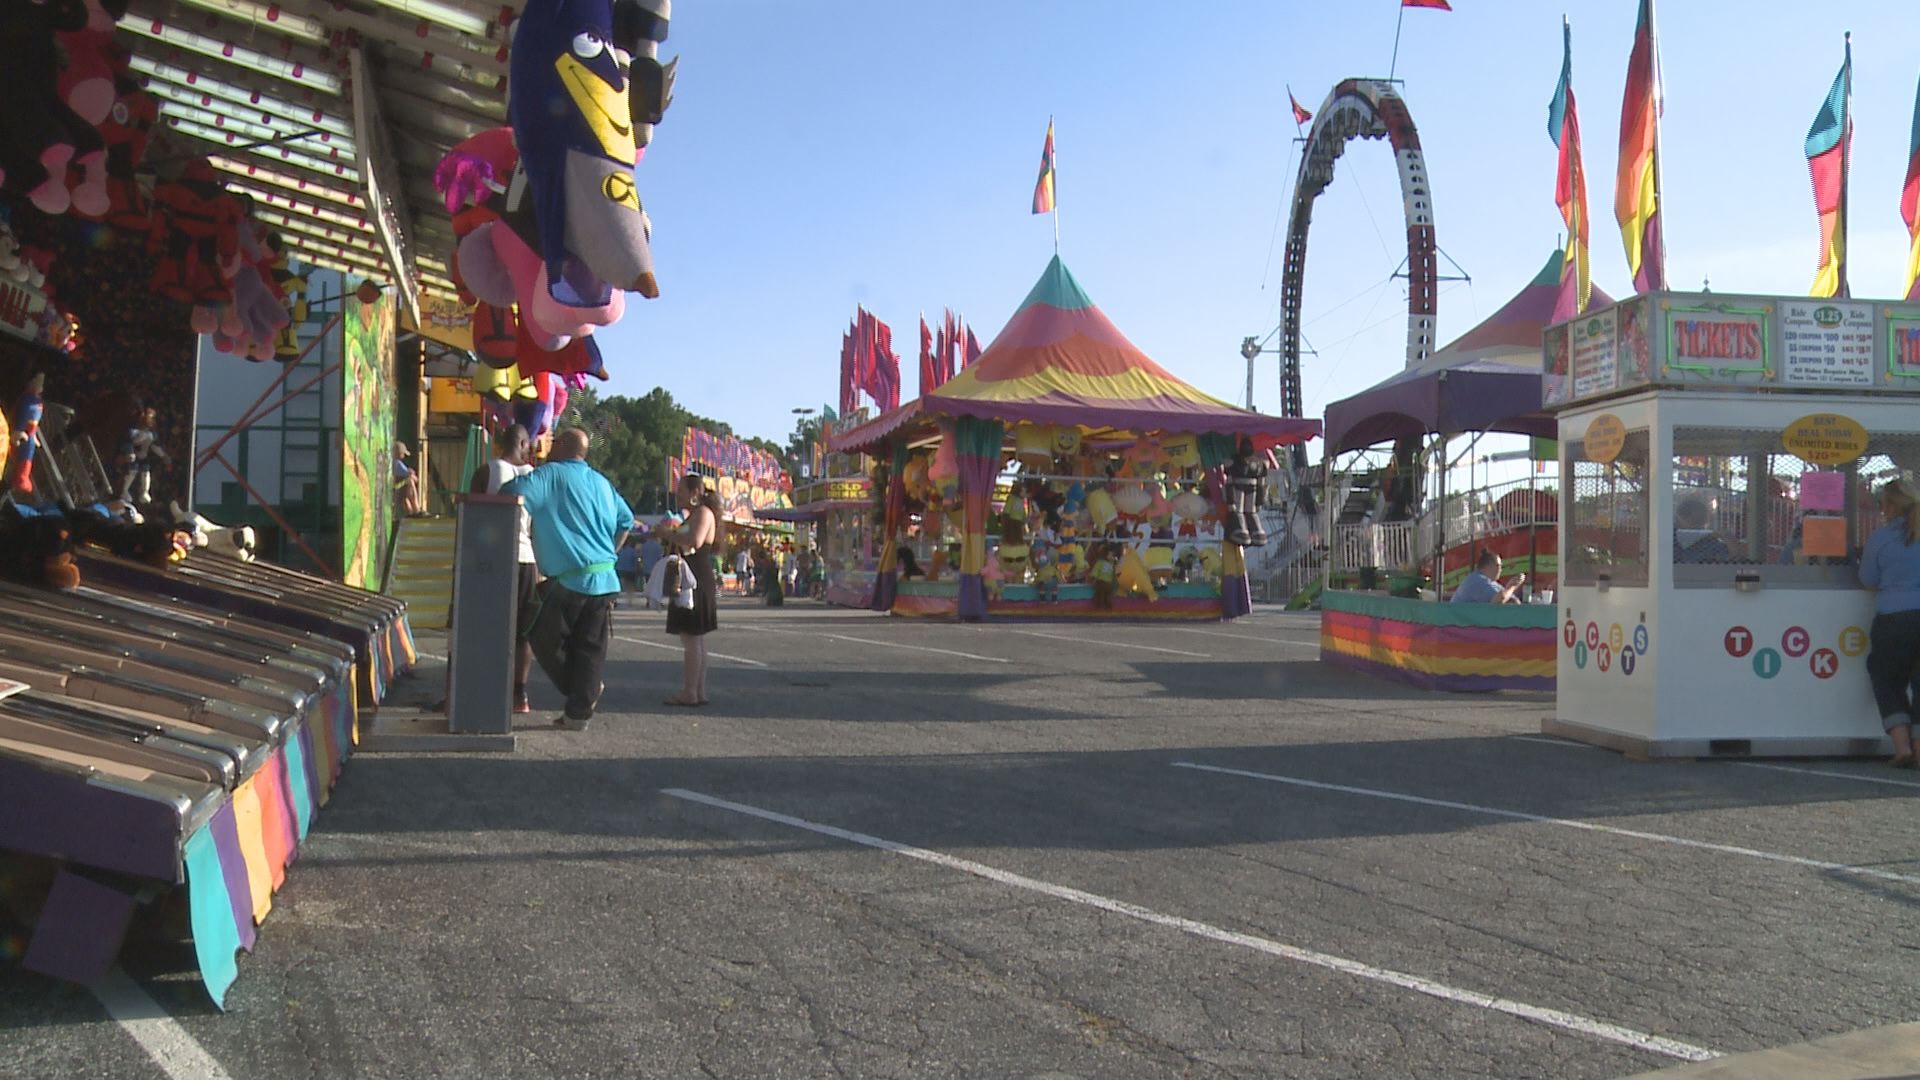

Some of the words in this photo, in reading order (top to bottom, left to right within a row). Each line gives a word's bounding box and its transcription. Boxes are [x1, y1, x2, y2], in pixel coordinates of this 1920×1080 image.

[1674, 319, 1761, 360] TICKETS
[1788, 437, 1832, 448] UNLIMITED
[802, 464, 810, 478] D
[830, 482, 862, 491] COLD
[1564, 619, 1649, 677] TICKETS
[1724, 625, 1870, 680] TICKE
